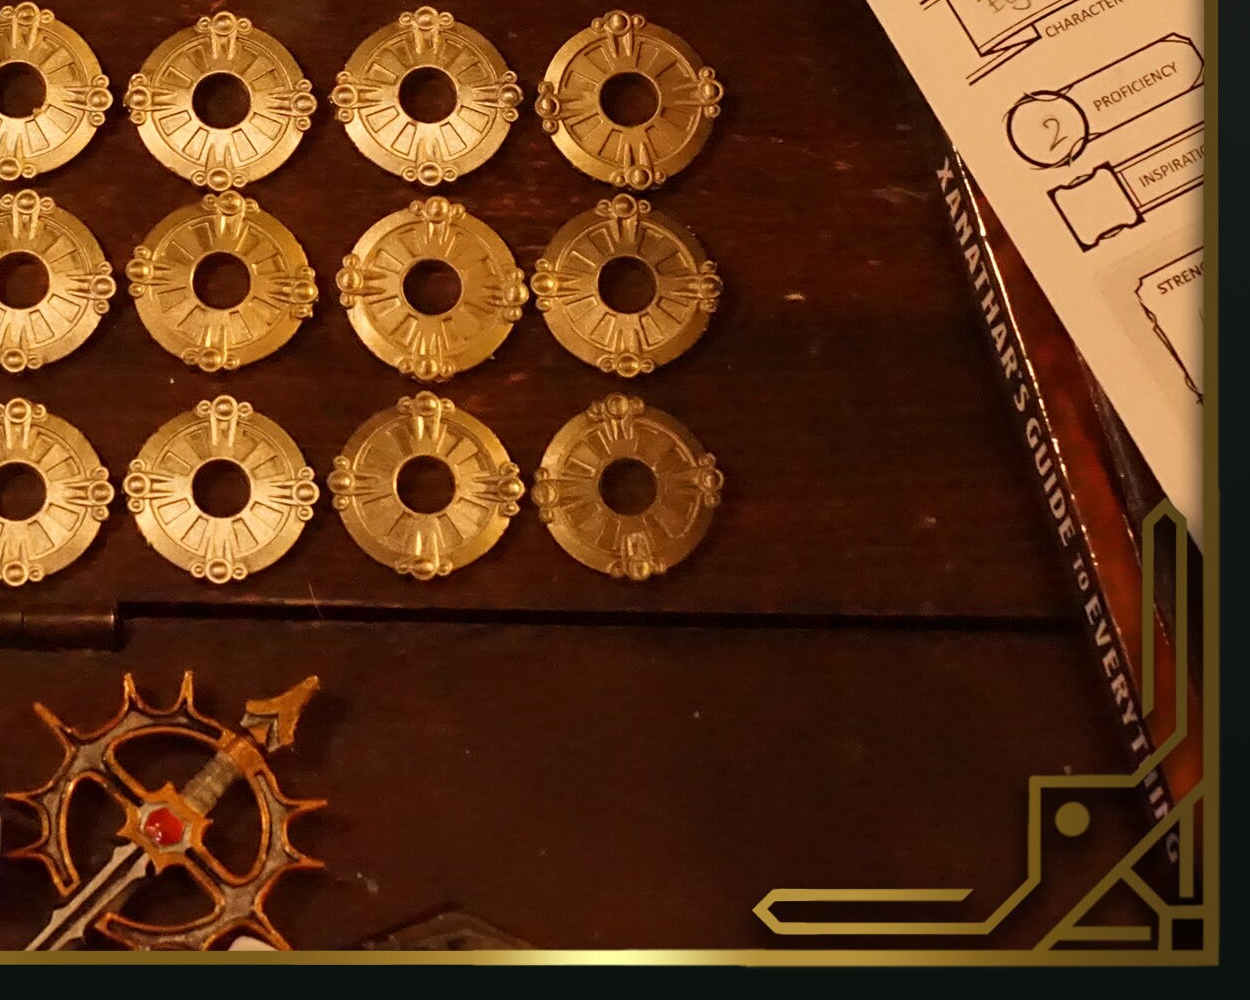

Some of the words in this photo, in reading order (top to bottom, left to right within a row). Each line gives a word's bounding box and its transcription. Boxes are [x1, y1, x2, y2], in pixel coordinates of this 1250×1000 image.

[1092, 61, 1179, 112] PROFICIENCY
[1043, 117, 1069, 151] 2
[936, 155, 1030, 413] XANATHAR'S
[1025, 416, 1076, 548] GUIDE
[1073, 551, 1091, 592] TO
